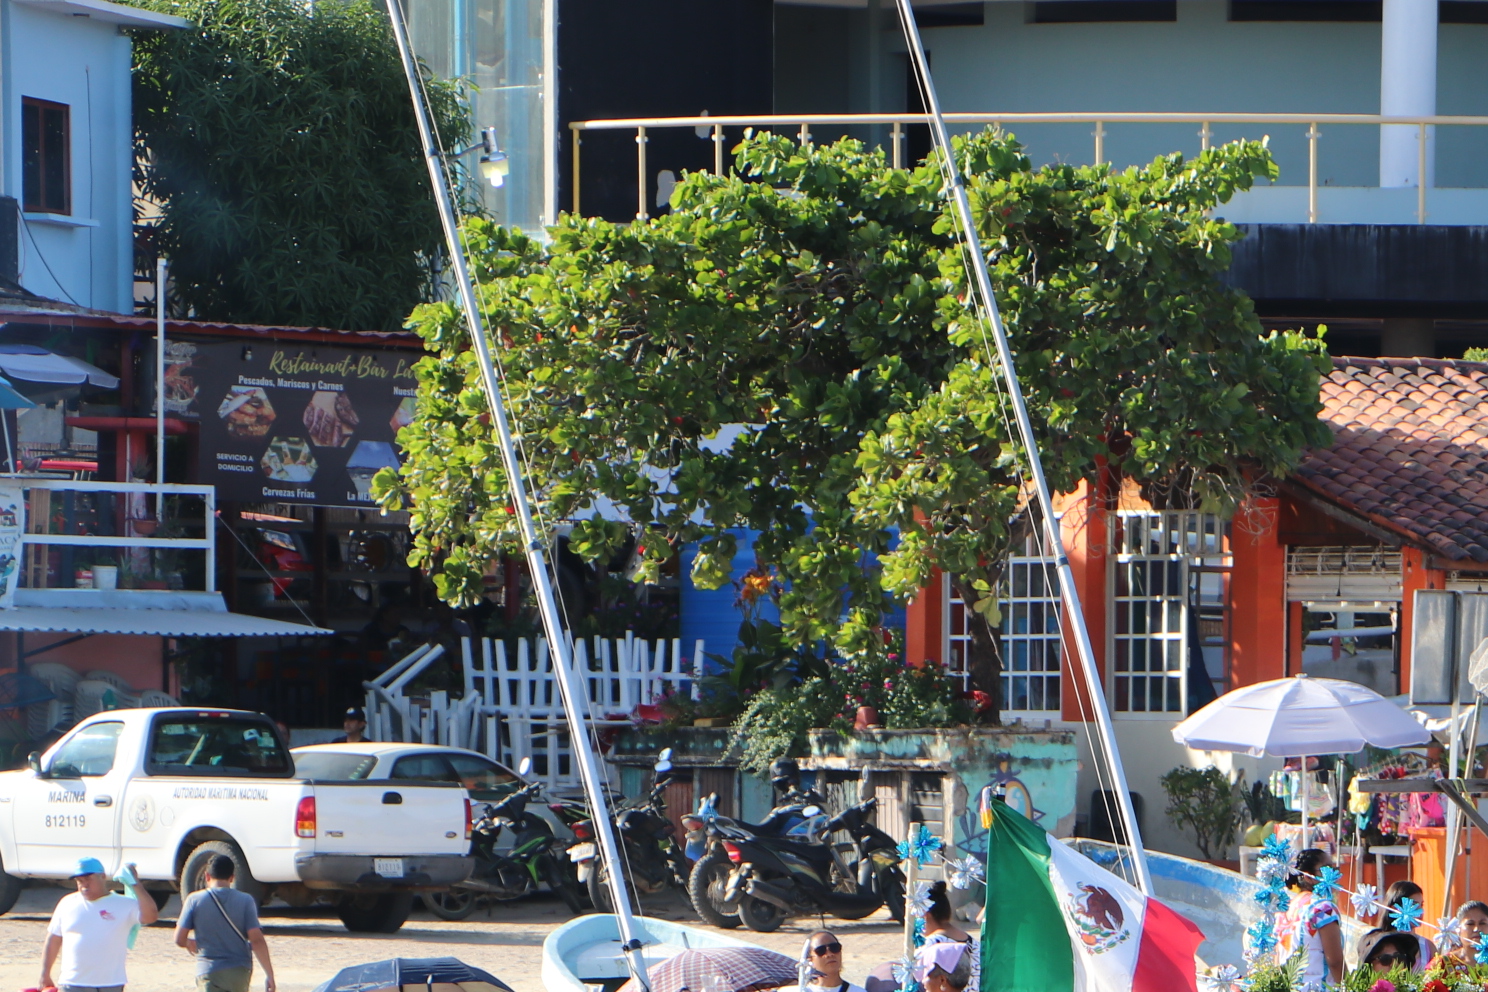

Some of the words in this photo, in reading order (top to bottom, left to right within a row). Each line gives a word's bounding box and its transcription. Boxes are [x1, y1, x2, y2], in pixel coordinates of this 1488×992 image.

[239, 375, 275, 387] Pescados,
[277, 378, 310, 389] Mariscos
[318, 380, 344, 391] Carnes
[216, 453, 246, 463] SERVICIO
[217, 462, 254, 473] DOMICILIO
[262, 486, 295, 499] Cervezas
[296, 486, 315, 500] Frías
[346, 491, 356, 501] La
[48, 790, 86, 804] MARINA
[173, 786, 207, 799] AUTORIDAD
[239, 788, 269, 801] NACIONAL
[45, 814, 86, 829] 812119
